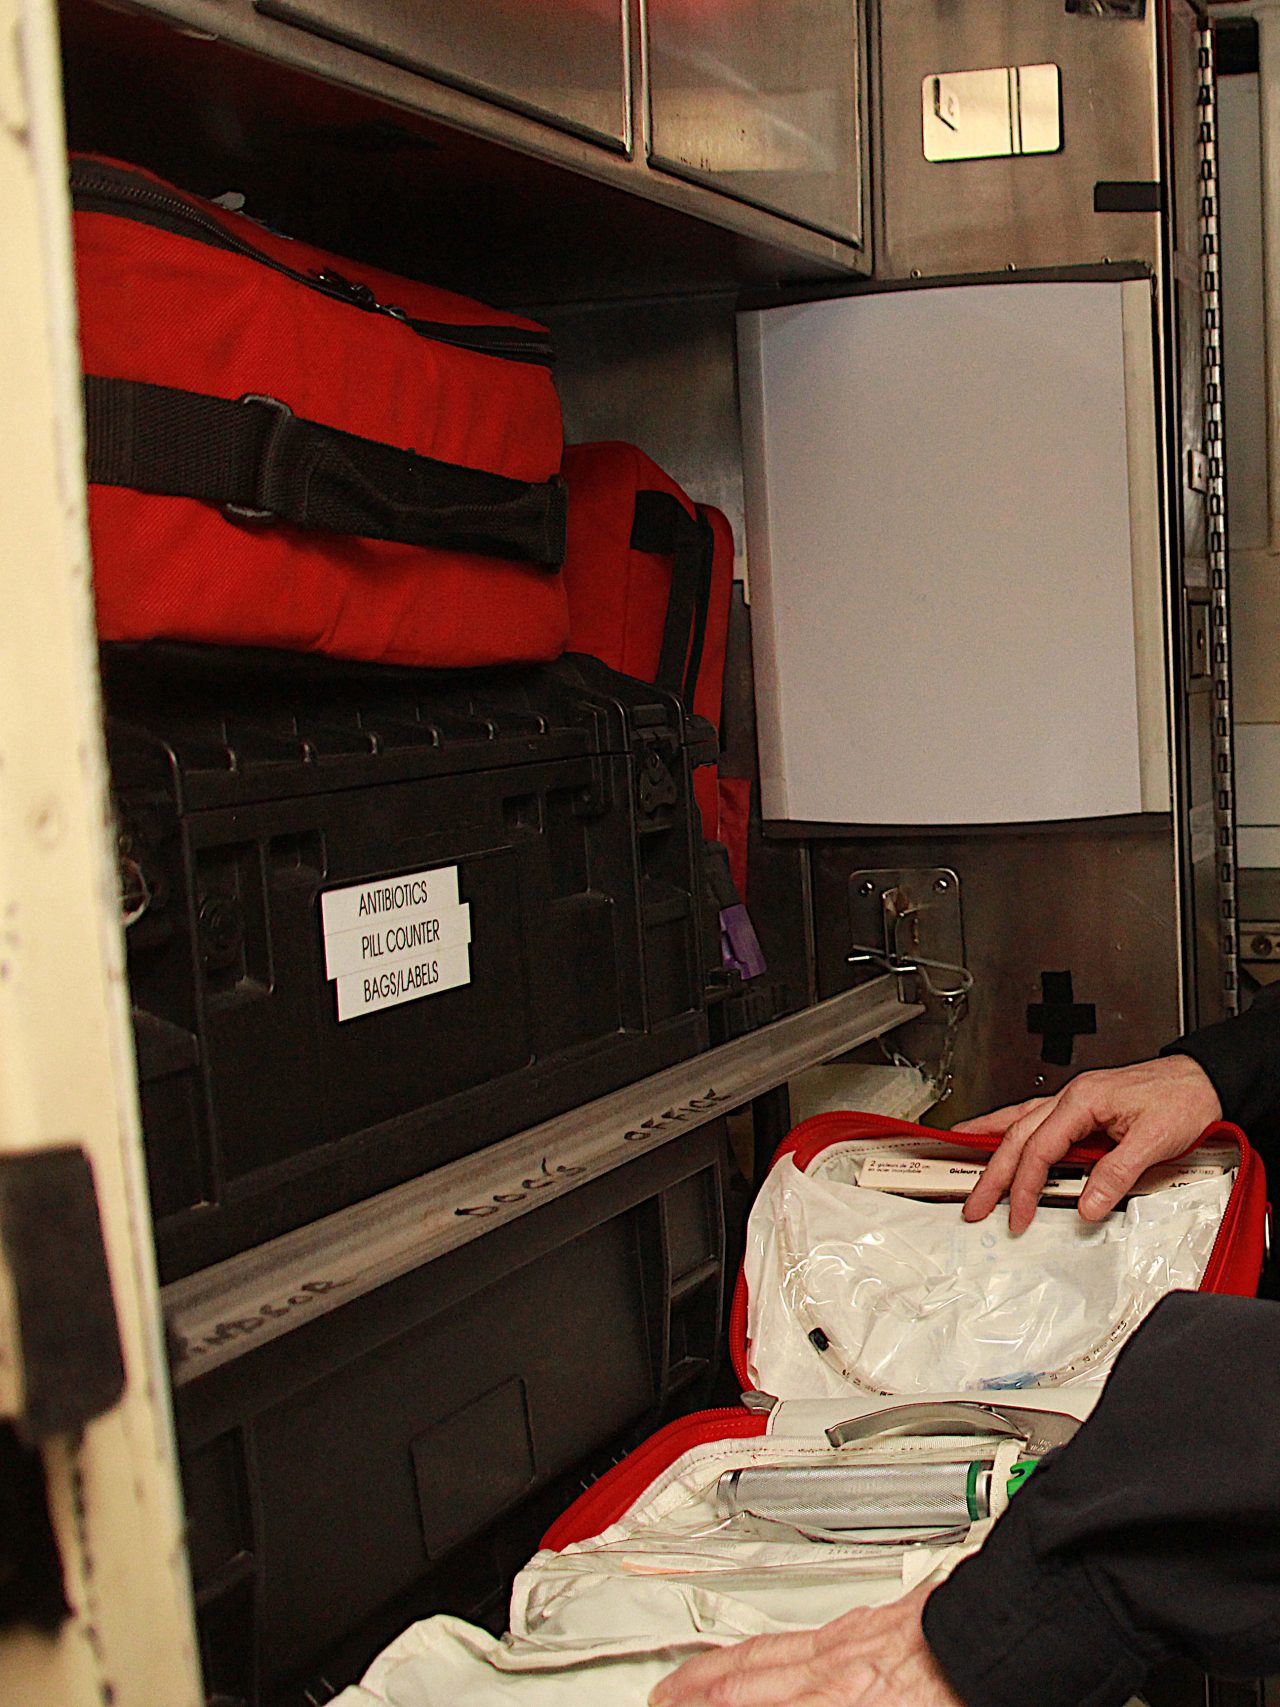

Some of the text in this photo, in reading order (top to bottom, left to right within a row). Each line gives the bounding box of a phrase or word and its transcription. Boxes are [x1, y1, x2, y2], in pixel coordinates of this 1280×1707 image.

[358, 880, 428, 917] ANTIBIOTICS
[361, 918, 440, 960] PILL COUNTER
[363, 960, 440, 1003] BAGS/LABELS
[623, 1088, 733, 1142] OFFICE
[909, 1161, 921, 1169] 20
